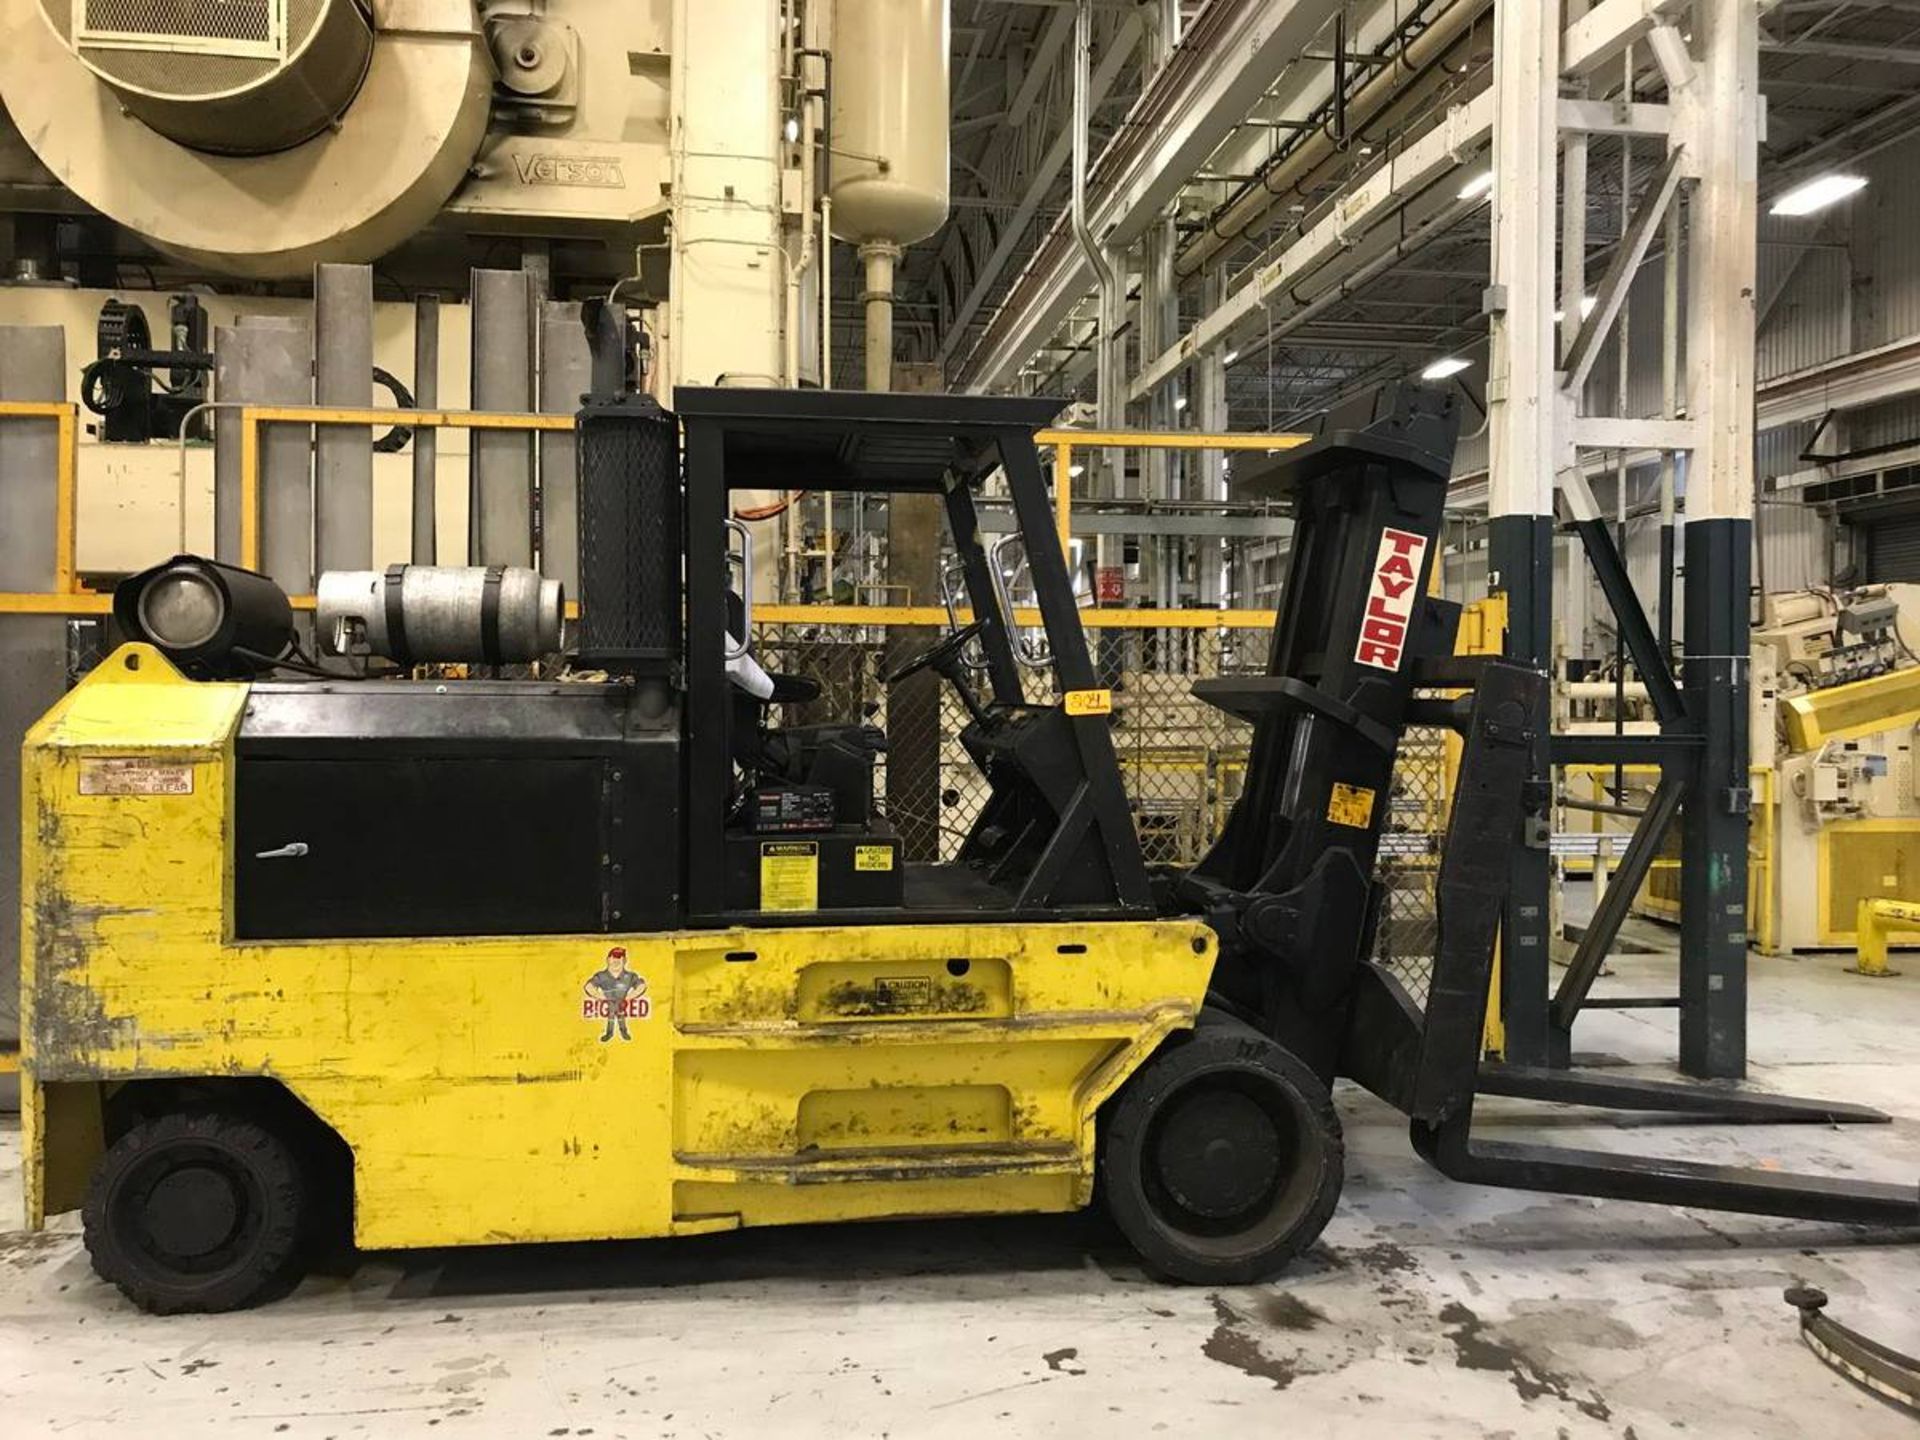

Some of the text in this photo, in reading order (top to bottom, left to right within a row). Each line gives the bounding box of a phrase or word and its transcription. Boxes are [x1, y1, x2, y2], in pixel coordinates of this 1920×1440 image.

[1358, 530, 1424, 668] TAYLOR
[152, 783, 189, 793] CLEAR
[888, 980, 928, 989] CAUTION
[617, 999, 649, 1018] RED
